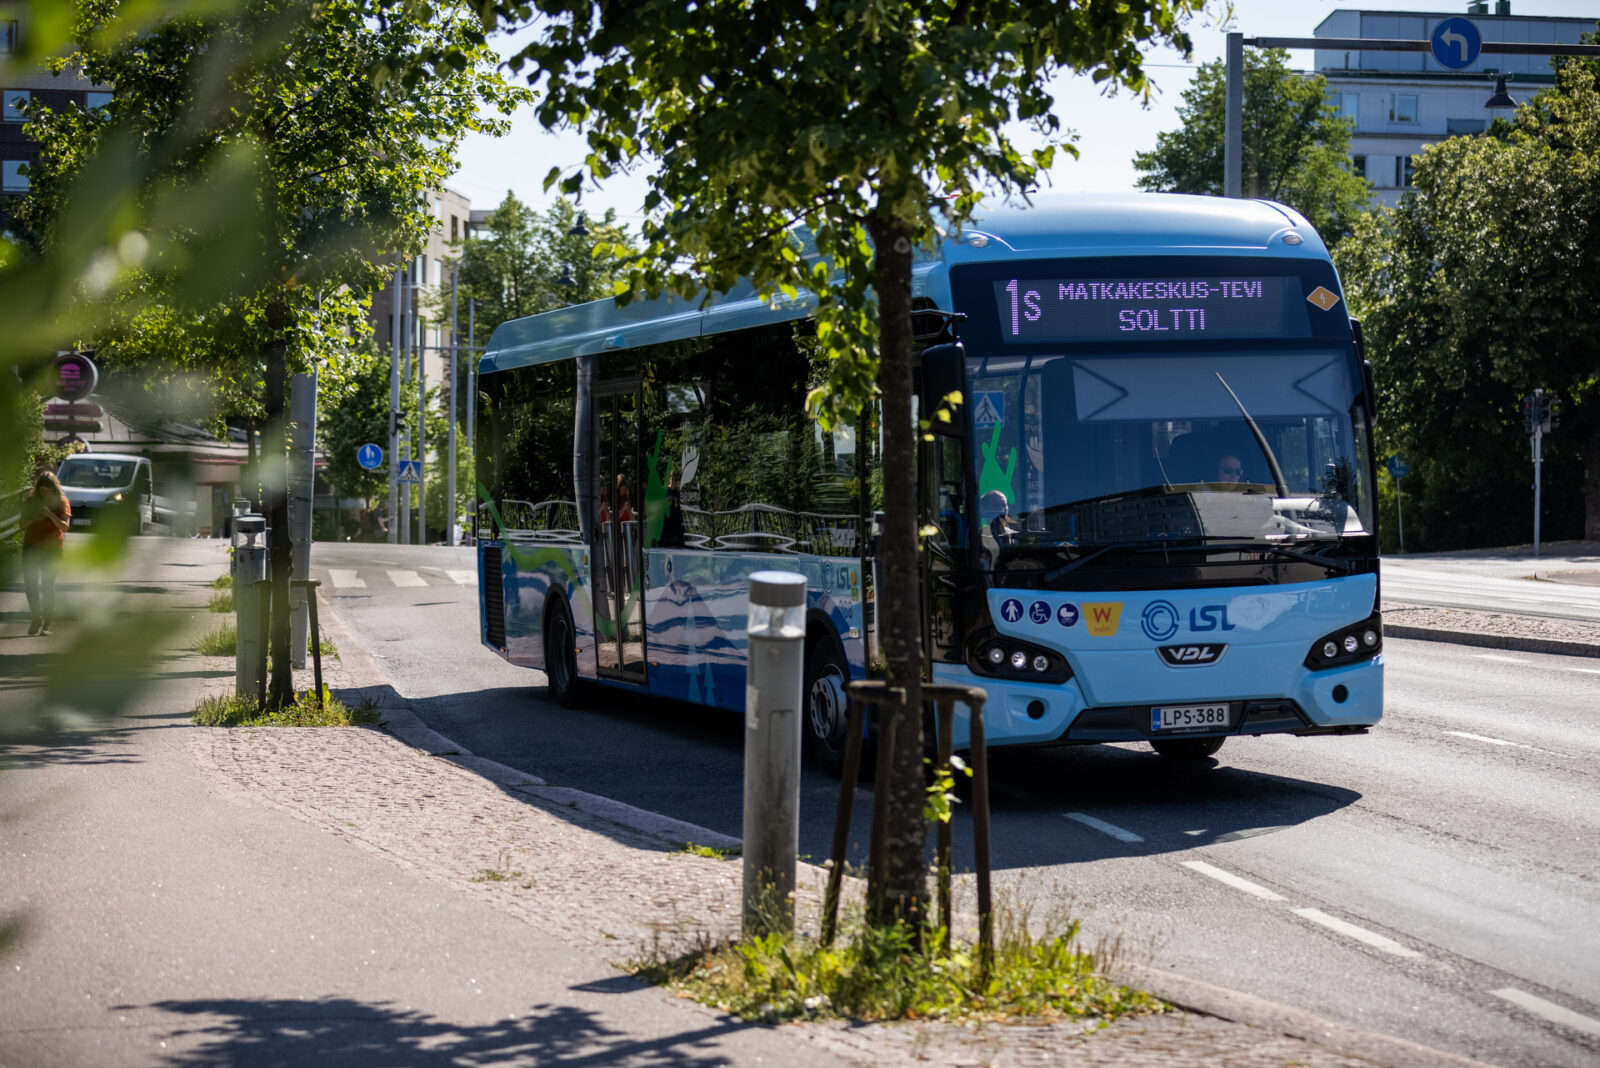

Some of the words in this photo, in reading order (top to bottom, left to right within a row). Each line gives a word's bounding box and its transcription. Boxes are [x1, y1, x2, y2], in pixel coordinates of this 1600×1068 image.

[1058, 281, 1262, 300] MATKAKESKUS-TEVI
[1119, 308, 1206, 331] SOLTTI
[837, 567, 851, 589] LSL
[1093, 607, 1112, 623] W
[1189, 604, 1236, 632] LSL
[1168, 646, 1216, 661] VDL
[1163, 707, 1225, 726] LPS-388
